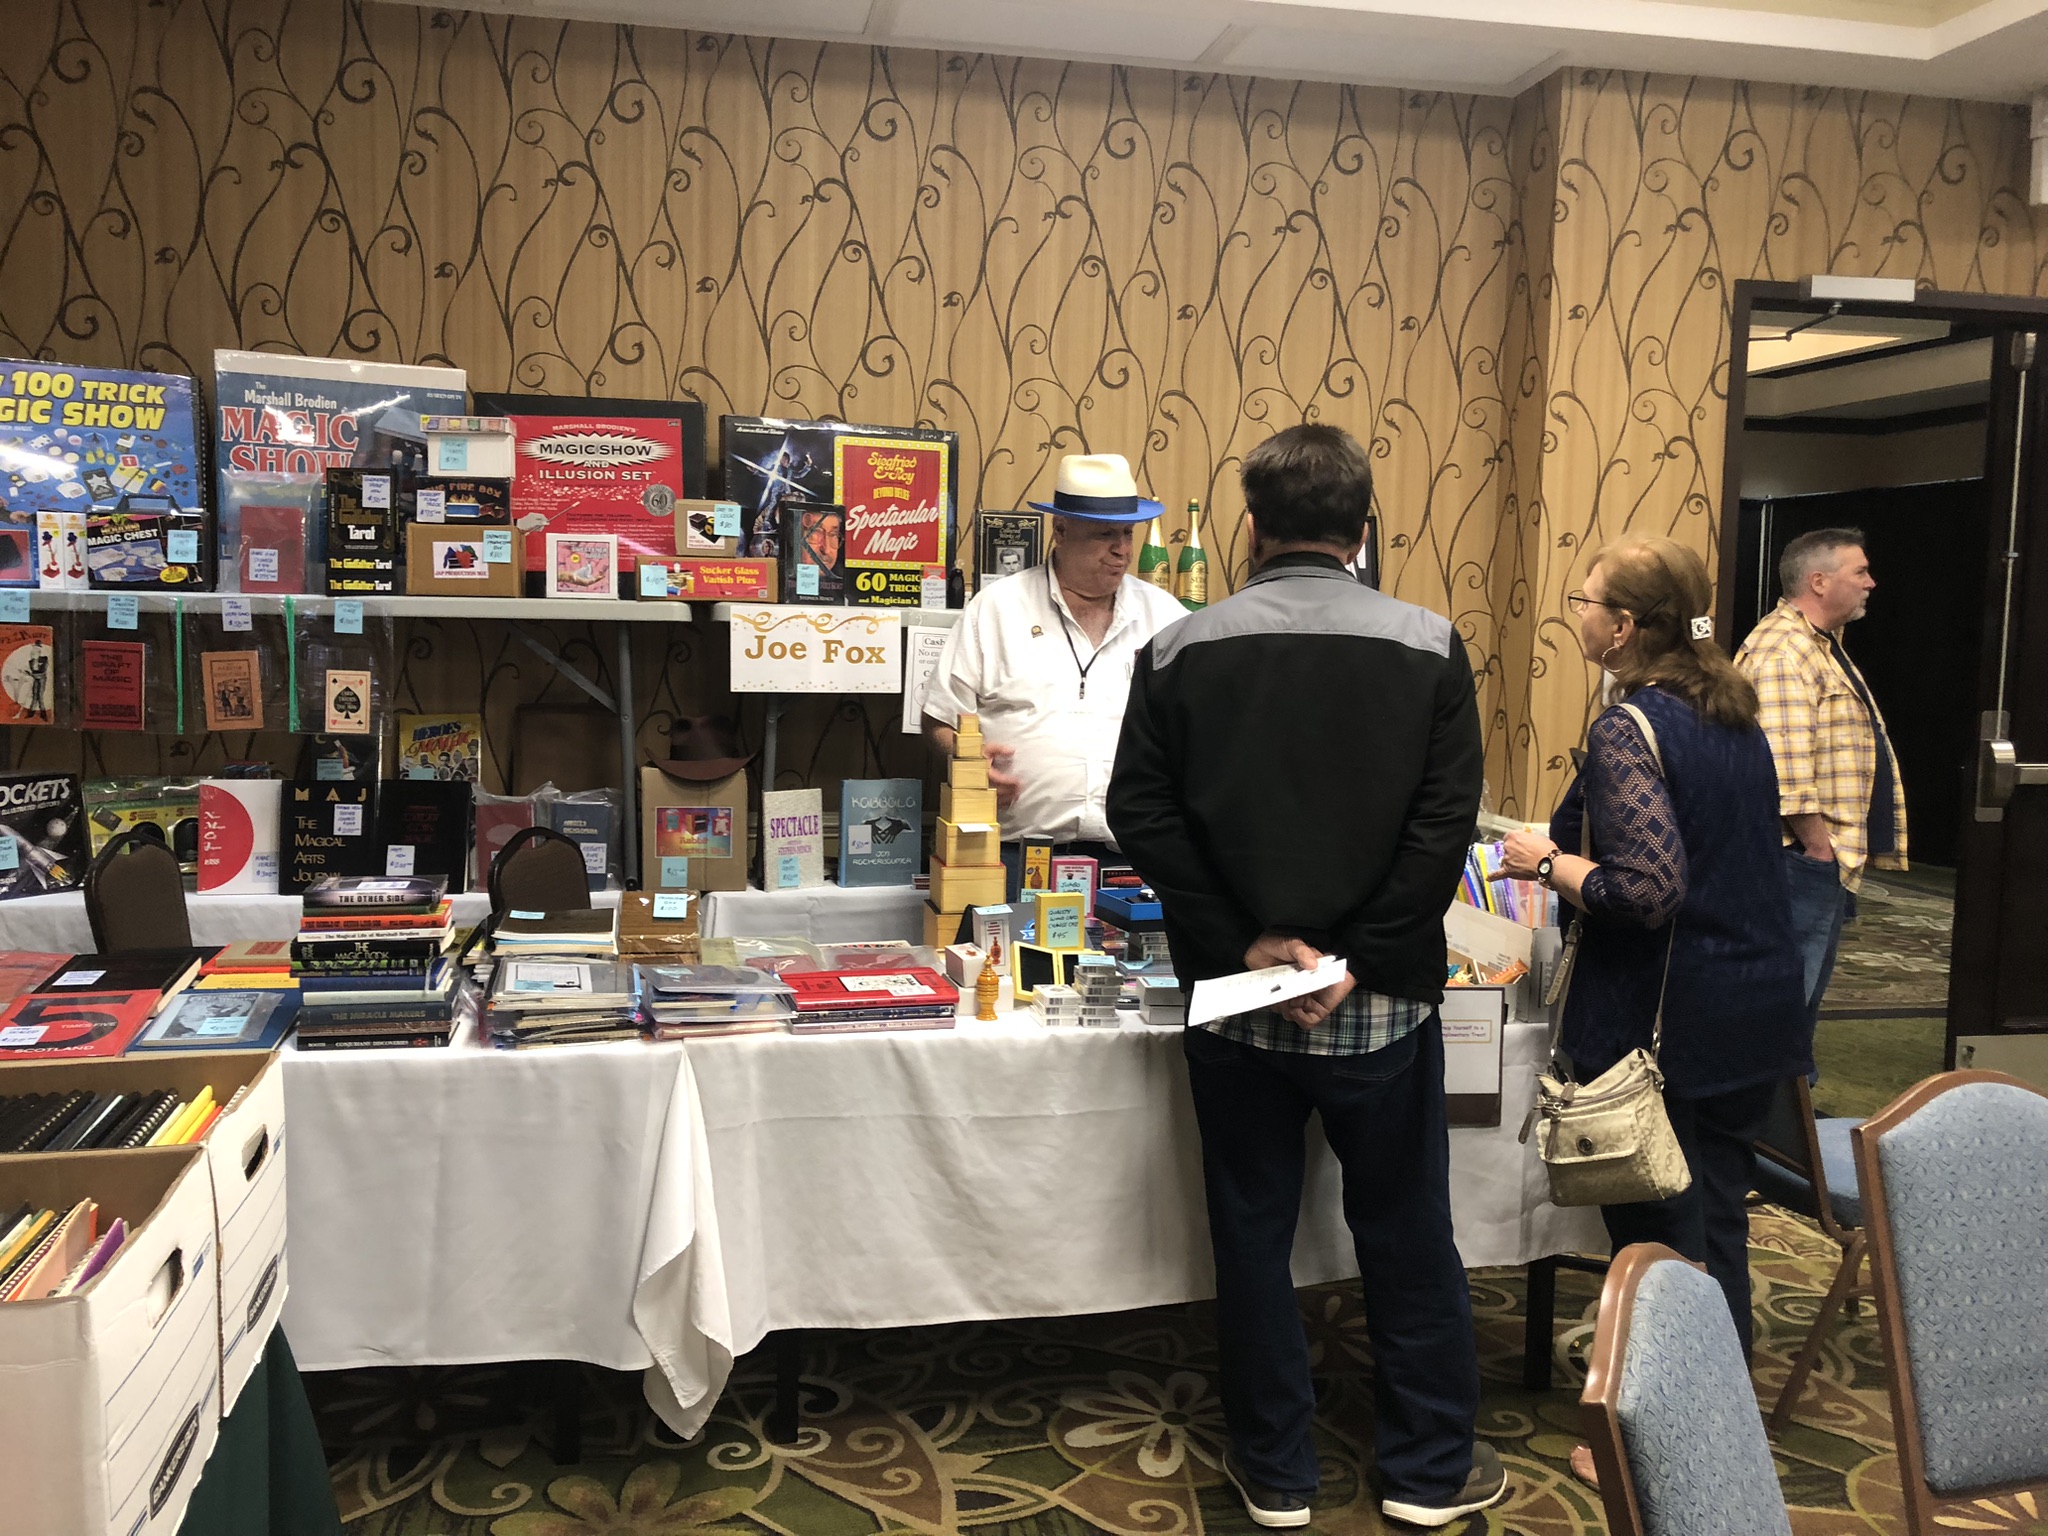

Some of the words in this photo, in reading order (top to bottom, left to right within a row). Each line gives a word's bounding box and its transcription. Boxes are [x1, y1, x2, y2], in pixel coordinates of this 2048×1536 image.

[12, 371, 75, 399] 100
[81, 381, 166, 405] TRICK
[255, 381, 266, 390] The
[244, 389, 292, 407] Marshall
[294, 393, 337, 410] Brodien
[62, 402, 166, 431] SHOW
[220, 405, 360, 452] MAGIC
[552, 423, 594, 431] MARSHALL
[539, 443, 596, 455] MAGIC
[599, 444, 652, 456] SHOW
[229, 444, 354, 485] SHOW
[583, 460, 610, 468] AND
[867, 451, 918, 471] Siegfried
[539, 469, 615, 480] ILLUSION
[621, 471, 653, 481] SET
[888, 466, 916, 486] Roy
[449, 483, 475, 492] FIRE
[478, 485, 502, 498] BOX
[651, 495, 668, 510] 60
[845, 499, 940, 540] Spectacular
[87, 534, 122, 546] MAGIC
[124, 529, 158, 545] CHEST
[347, 525, 376, 541] Tarot
[864, 529, 918, 560] Magic
[375, 559, 392, 570] Tarot
[700, 565, 732, 575] Sucker
[734, 566, 759, 575] Glass
[375, 580, 392, 591] Tarot
[702, 575, 734, 584] Vanish
[736, 576, 757, 585] Plus
[855, 572, 887, 592] 60
[889, 573, 921, 582] MAGIC
[870, 595, 919, 606] Magician's
[744, 634, 807, 660] Joe
[821, 638, 886, 664] Fox
[918, 648, 930, 657] No
[294, 816, 317, 830] THE
[770, 815, 820, 840] SPECTACLE
[294, 833, 347, 848] MAGICAL
[293, 851, 326, 865] ARTS
[338, 894, 354, 903] THE
[356, 894, 384, 903] OTHER
[387, 894, 405, 903] SIDE
[354, 941, 370, 951] THE
[0, 993, 133, 1050] 5
[331, 1012, 349, 1021] THE
[350, 1011, 387, 1020] MIRACLE
[14, 1045, 95, 1054] SCOTLAND
